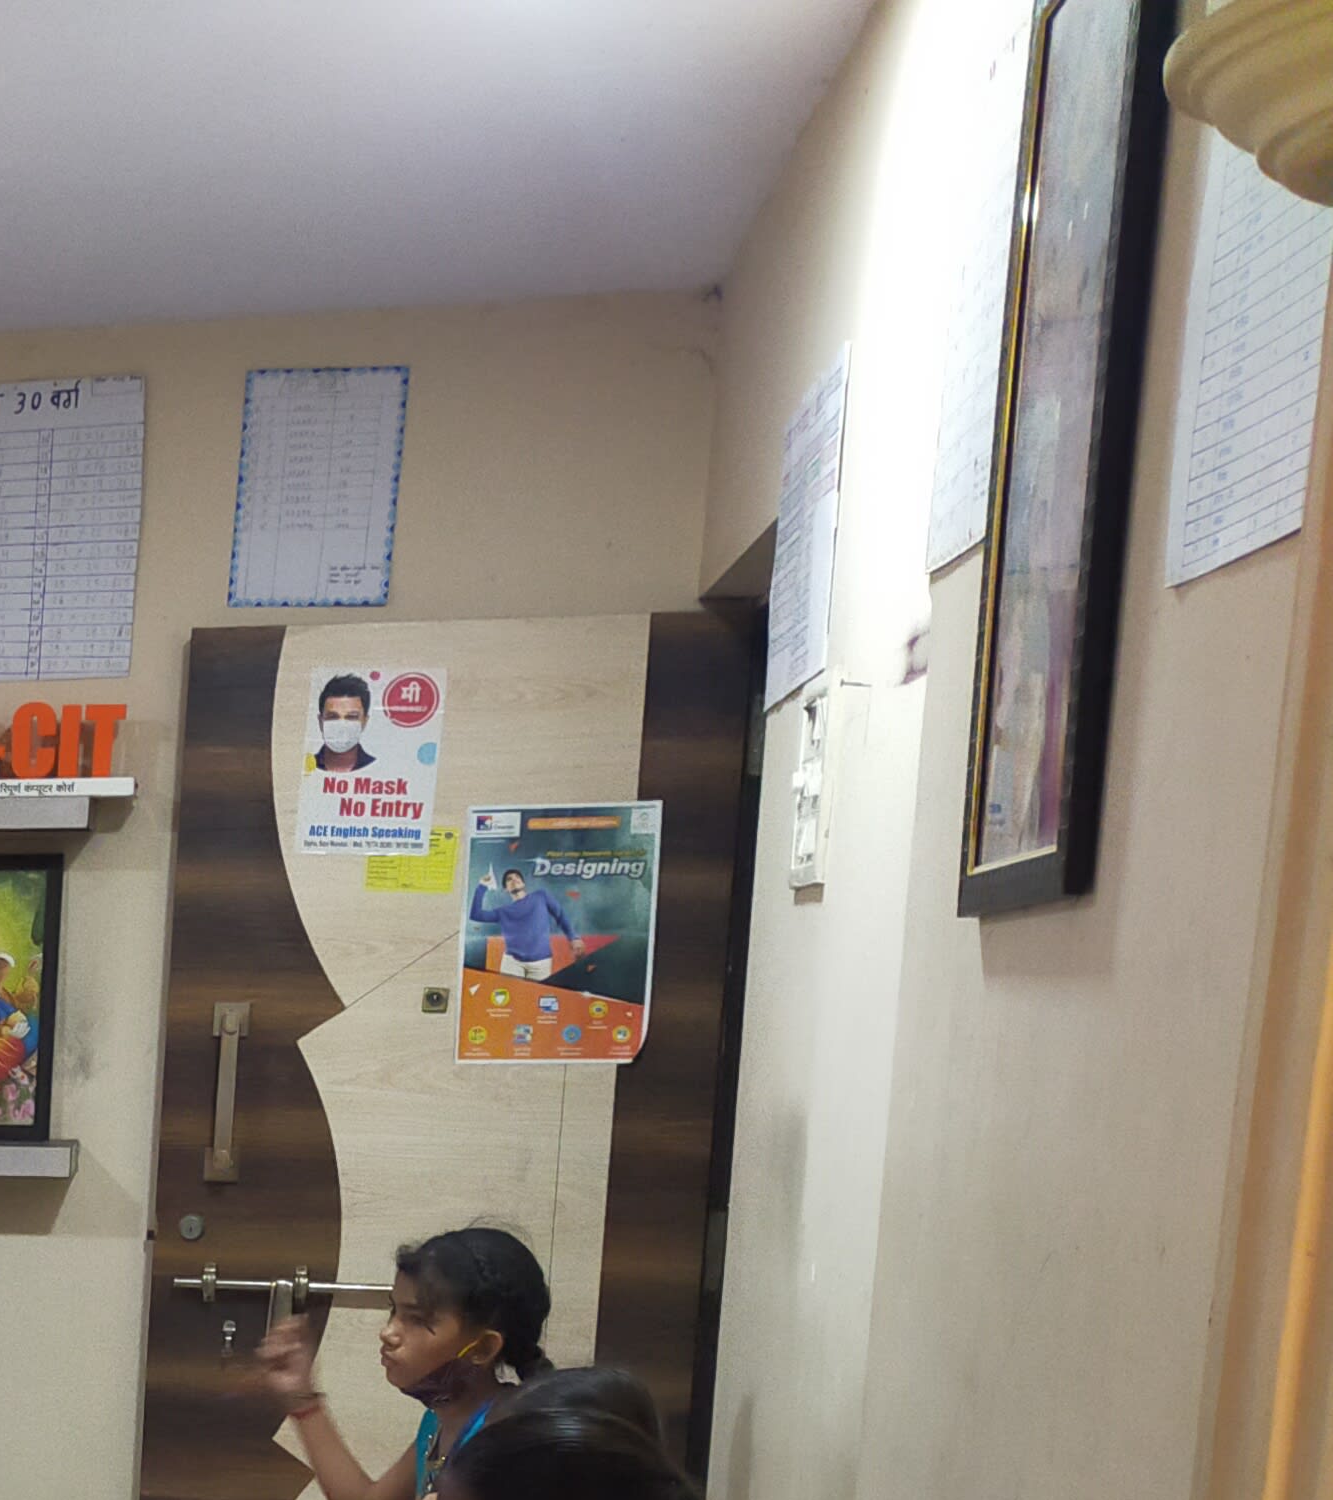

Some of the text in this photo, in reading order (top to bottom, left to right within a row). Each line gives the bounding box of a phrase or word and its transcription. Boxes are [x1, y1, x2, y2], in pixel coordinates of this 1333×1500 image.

[14, 391, 42, 415] 30
[323, 776, 408, 795] No Mask
[339, 798, 424, 820] No Entry
[309, 825, 422, 840] ACE English Speaking
[534, 857, 645, 879] Designing
